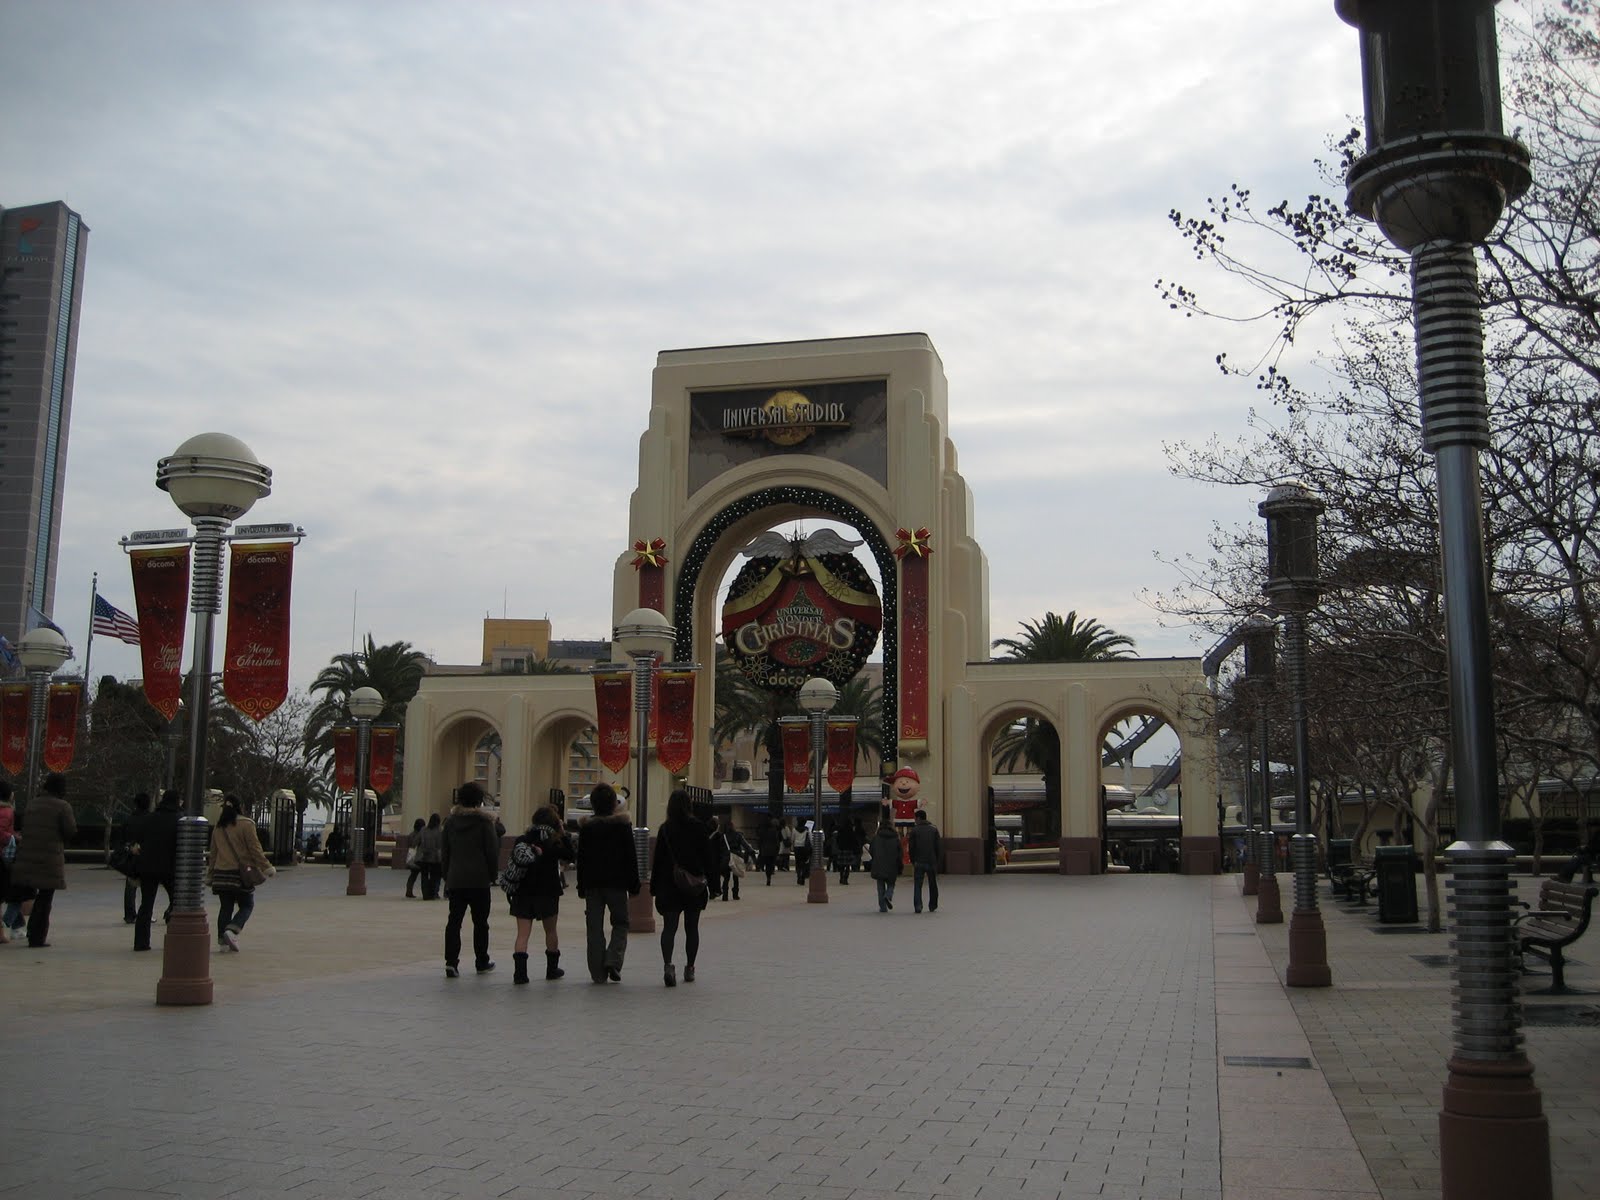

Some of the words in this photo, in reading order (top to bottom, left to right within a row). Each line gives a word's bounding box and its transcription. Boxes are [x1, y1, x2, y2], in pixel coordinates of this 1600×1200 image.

[723, 406, 788, 429] UNIVERSAL
[792, 402, 846, 423] STUDIOS
[133, 532, 160, 541] UNIVERSAL
[161, 530, 185, 539] STUDIOS
[147, 560, 175, 569] docomo
[247, 555, 277, 564] docomo
[776, 606, 825, 617] UNIVERSAL
[777, 615, 824, 625] WONDER
[247, 641, 274, 656] Merry
[234, 653, 283, 668] Christmas
